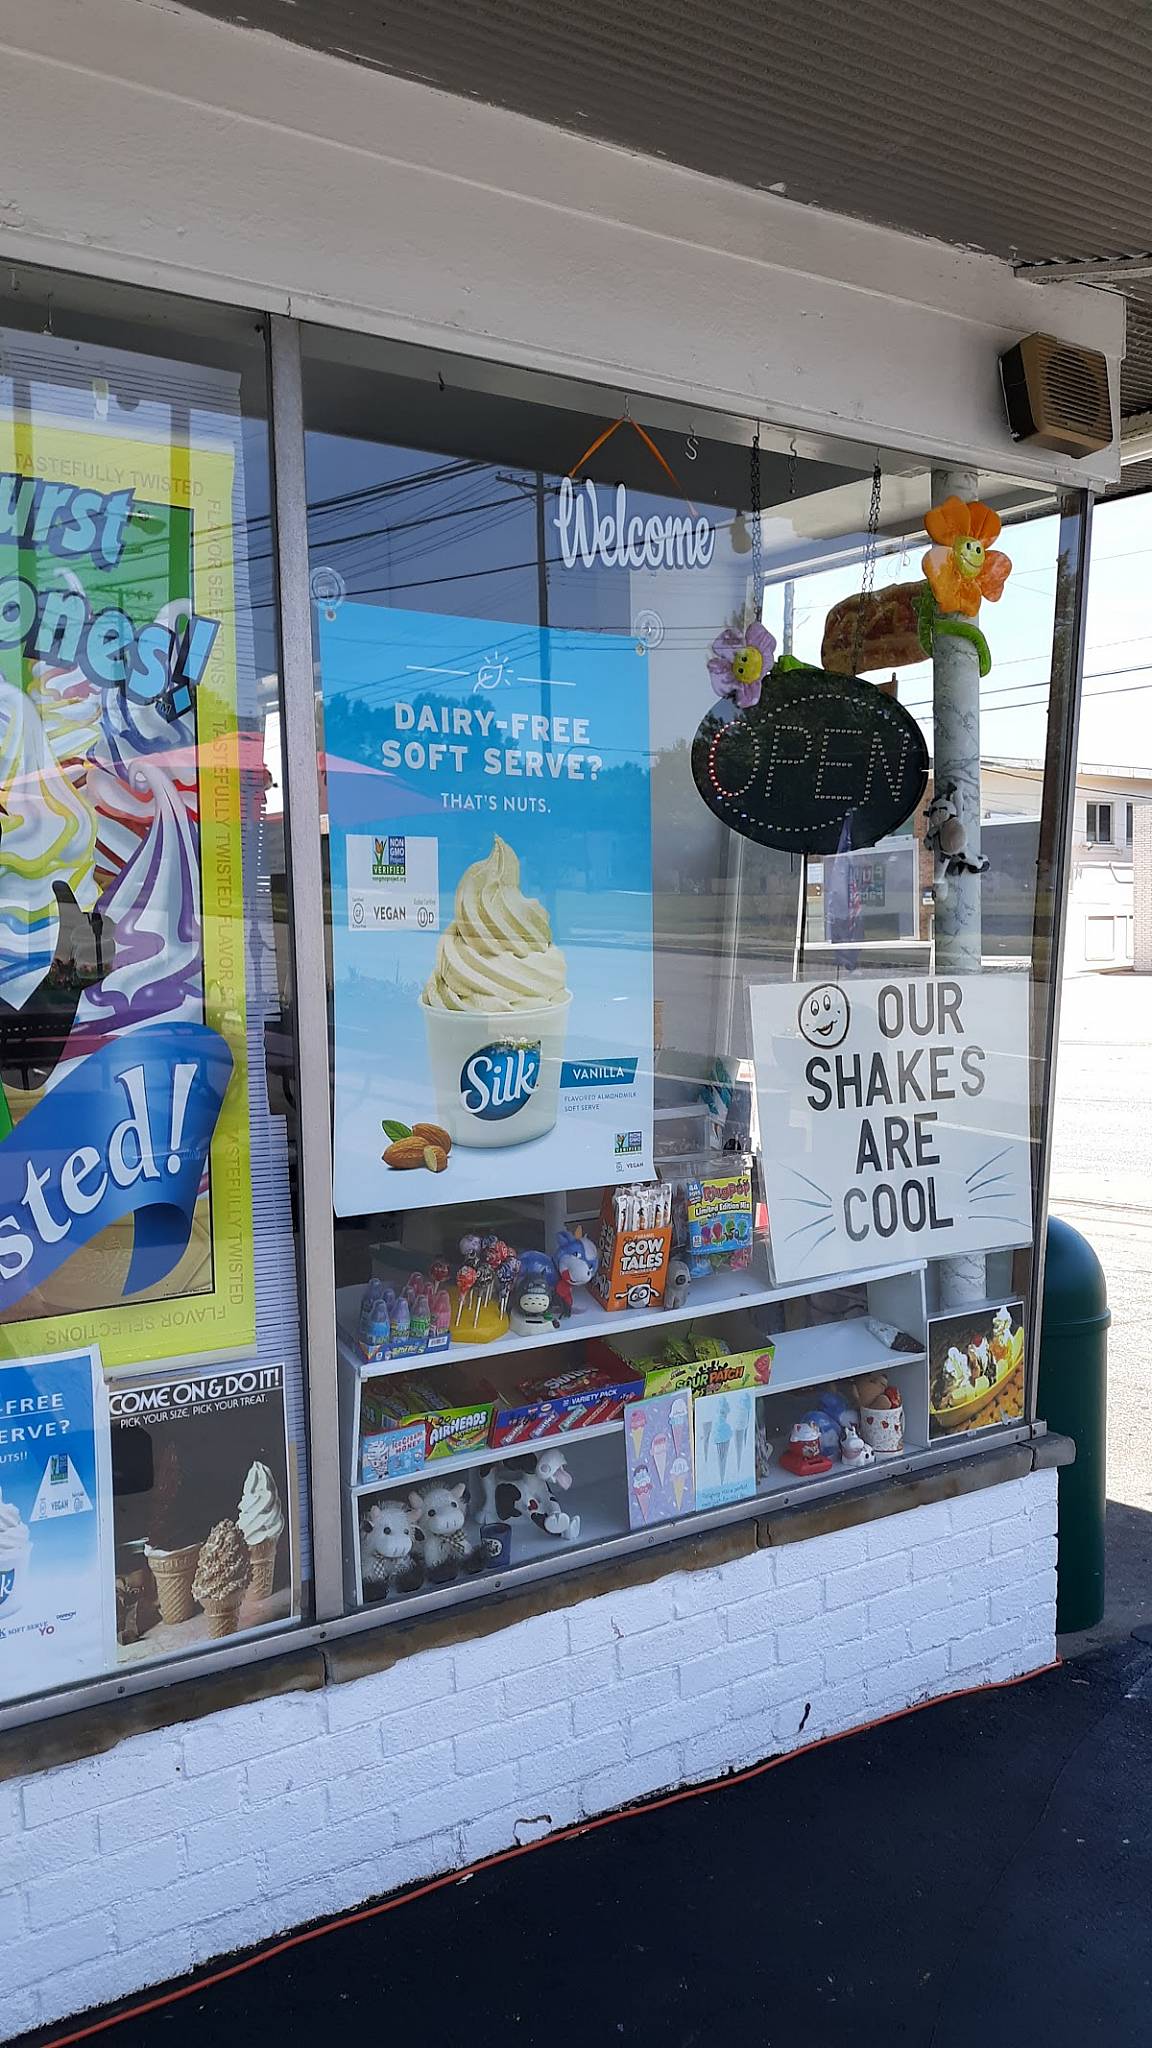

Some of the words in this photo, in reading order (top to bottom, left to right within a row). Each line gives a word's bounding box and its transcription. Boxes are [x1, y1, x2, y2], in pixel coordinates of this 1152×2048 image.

[14, 453, 127, 484] TASTEFULLY
[130, 470, 204, 497] TWISTED
[207, 498, 223, 569] FLAVOR
[554, 475, 717, 571] Welcome
[394, 702, 591, 745] DAIRY-FREE
[211, 719, 231, 830] TASTEFULLY
[381, 739, 469, 773] SOFT
[484, 747, 602, 782] SERVE?
[709, 719, 910, 802] OPEN
[440, 792, 497, 811] THAT'S
[503, 795, 551, 814] NUTS.
[389, 838, 405, 847] NON
[389, 847, 405, 857] GMO
[214, 832, 233, 909] TWISTED
[373, 866, 405, 875] VERIFIED
[373, 906, 407, 920] VEGAN
[217, 913, 235, 979] FLAVOR
[878, 981, 965, 1039] OUR
[461, 1050, 541, 1114] Silk
[573, 1067, 625, 1080] VANILLA
[805, 1045, 986, 1111] SHAKES
[564, 1094, 596, 1102] FLAVORED
[597, 1091, 637, 1100] ALMONDMILK
[564, 1104, 580, 1112] SOFT
[581, 1103, 600, 1111] SERVE
[855, 1111, 941, 1175] ARE
[224, 1127, 243, 1228] TASTEFULLY
[695, 1205, 718, 1217] Limited
[719, 1202, 740, 1211] Edition
[740, 1201, 750, 1210] Mix
[843, 1176, 954, 1242] COOL
[620, 1252, 663, 1271] TALES
[623, 1238, 664, 1257] COW
[228, 1231, 244, 1305] TWISTED
[161, 1304, 227, 1329] FLAVOR
[109, 1387, 170, 1416] COME
[172, 1380, 209, 1404] ON
[225, 1372, 257, 1395] DO
[259, 1367, 281, 1389] IT!
[709, 1366, 745, 1383] PATCH
[120, 1417, 141, 1430] PICK
[142, 1411, 169, 1425] YOUR
[192, 1402, 213, 1416] PICK
[213, 1398, 239, 1412] YOUR
[239, 1394, 268, 1406] TREAT.
[571, 1392, 599, 1405] VARIETY
[599, 1388, 618, 1399] PACK
[429, 1411, 488, 1446] AIRHEADS
[50, 1499, 69, 1512] VEGAN
[38, 1625, 55, 1637] YO
